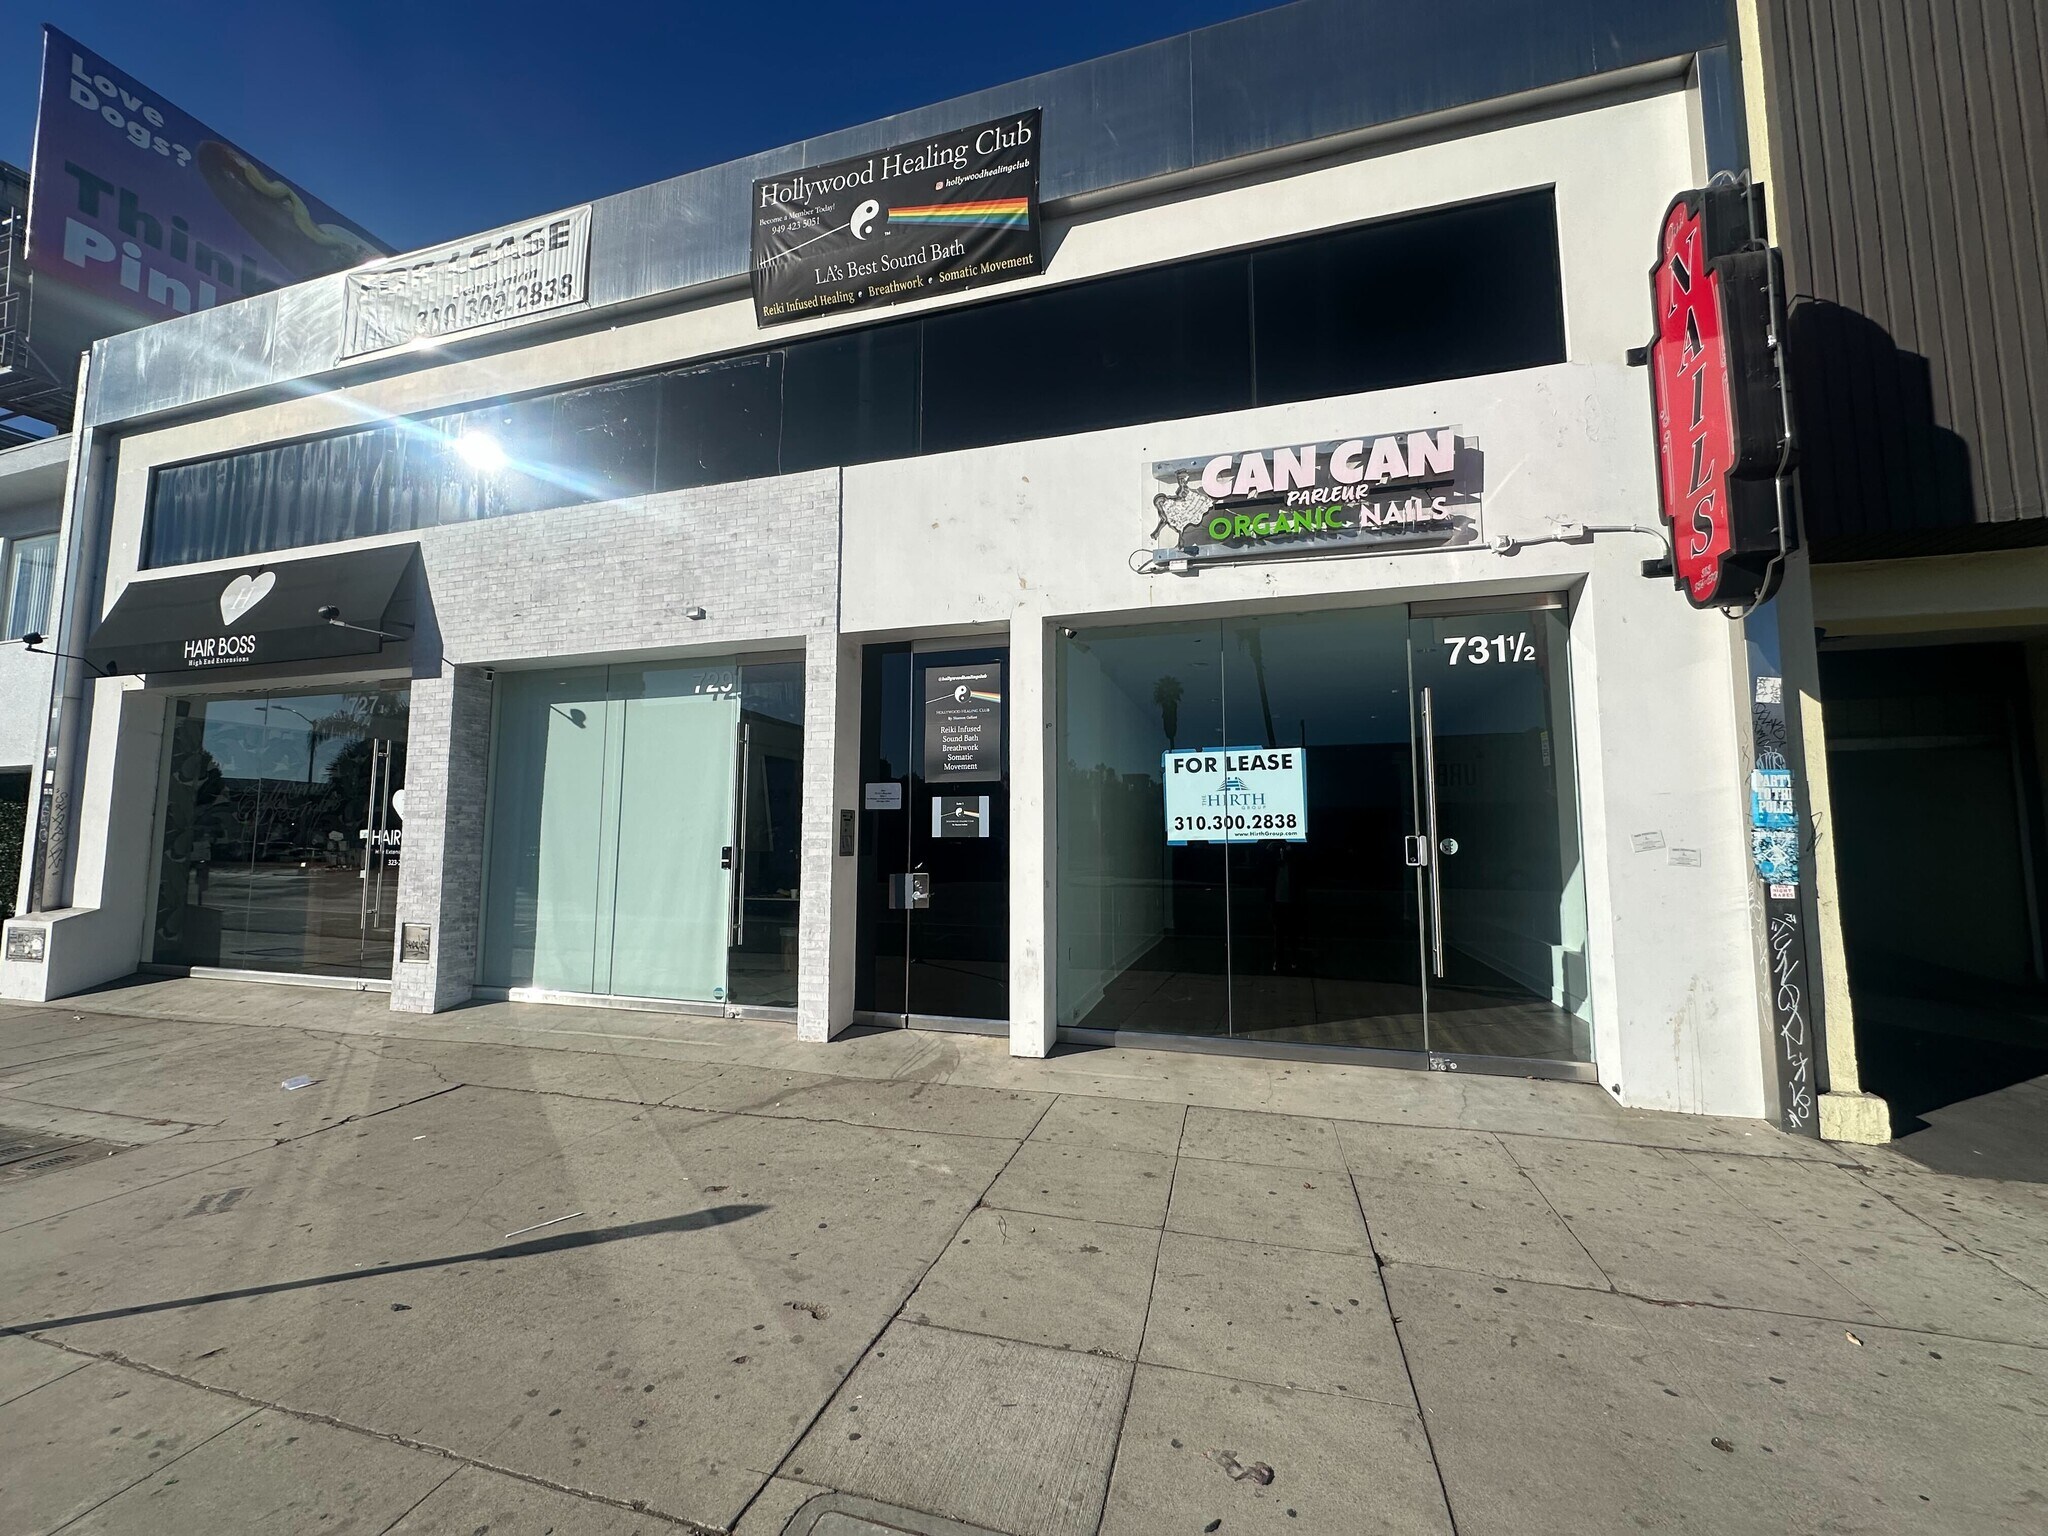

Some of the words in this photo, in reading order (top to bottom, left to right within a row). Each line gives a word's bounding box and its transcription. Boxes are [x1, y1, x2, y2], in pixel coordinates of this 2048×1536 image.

[72, 53, 164, 127] Love
[70, 78, 192, 167] Dogs?
[760, 160, 874, 208] Hollywood
[881, 144, 969, 181] Healing
[975, 121, 1032, 155] Club
[945, 158, 1031, 187] hollywoodhealingclub
[759, 216, 783, 226] Become
[788, 209, 814, 220] Member
[814, 203, 836, 214] Today!
[771, 225, 786, 236] 949
[787, 221, 801, 231] 423
[802, 217, 820, 229] 5051
[847, 259, 878, 279] Best
[881, 246, 927, 272] Sound
[930, 239, 965, 262] Bath
[763, 303, 785, 317] Reiki
[786, 295, 819, 313] Infused
[820, 291, 855, 305] Healing
[868, 274, 924, 298] Breathwork
[939, 264, 978, 283] Somatic
[980, 253, 1034, 274] Movement
[417, 273, 573, 334] 310300.2838
[1668, 226, 1715, 560] NAILS
[1201, 445, 1316, 498] CAN
[1329, 429, 1456, 485] CAN
[1286, 483, 1369, 507] PARLEUR
[1208, 505, 1344, 541] ORGANIC
[1359, 496, 1452, 529] NAILS
[184, 638, 215, 659] HAIR
[218, 634, 256, 656] BOSS
[188, 658, 202, 667] High
[216, 656, 249, 665] Extensions
[940, 725, 956, 734] Reiki
[957, 724, 981, 733] Infused
[942, 735, 963, 743] Sound
[964, 734, 979, 742] Bath
[942, 744, 979, 752] Breathwork
[947, 753, 974, 761] Somatic
[943, 762, 978, 771] Movement
[1174, 757, 1218, 774] FOR
[1226, 753, 1293, 772] LEASE
[1208, 793, 1265, 807] HIRTH
[1758, 801, 1794, 814] POLLS
[1174, 814, 1297, 831] 310.300.2838
[371, 829, 401, 846] HAIR
